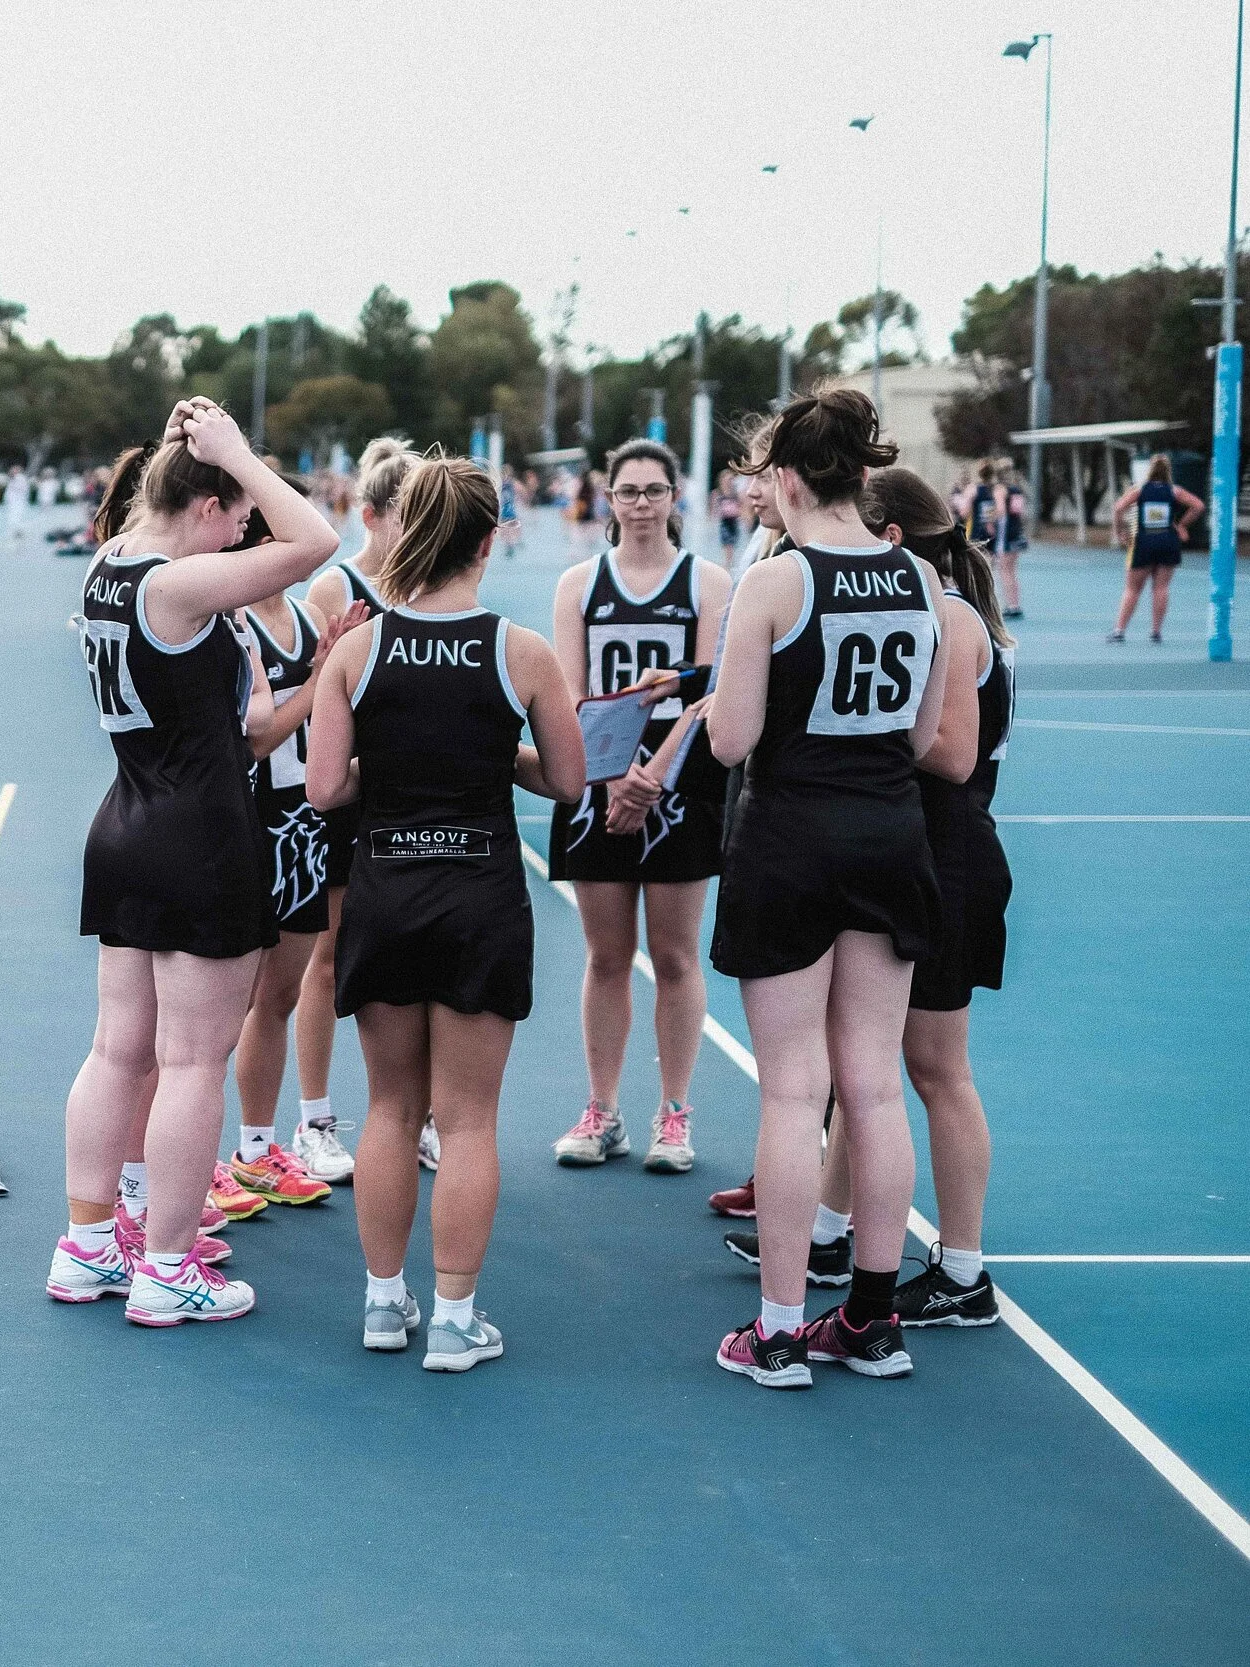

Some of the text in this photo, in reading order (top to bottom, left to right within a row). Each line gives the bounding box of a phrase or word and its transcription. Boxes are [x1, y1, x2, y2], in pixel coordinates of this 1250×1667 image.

[86, 575, 132, 606] AUNC
[834, 570, 911, 597] AUNC
[386, 637, 482, 667] AUNC
[831, 631, 916, 716] GS
[391, 830, 469, 844] ANGOVE
